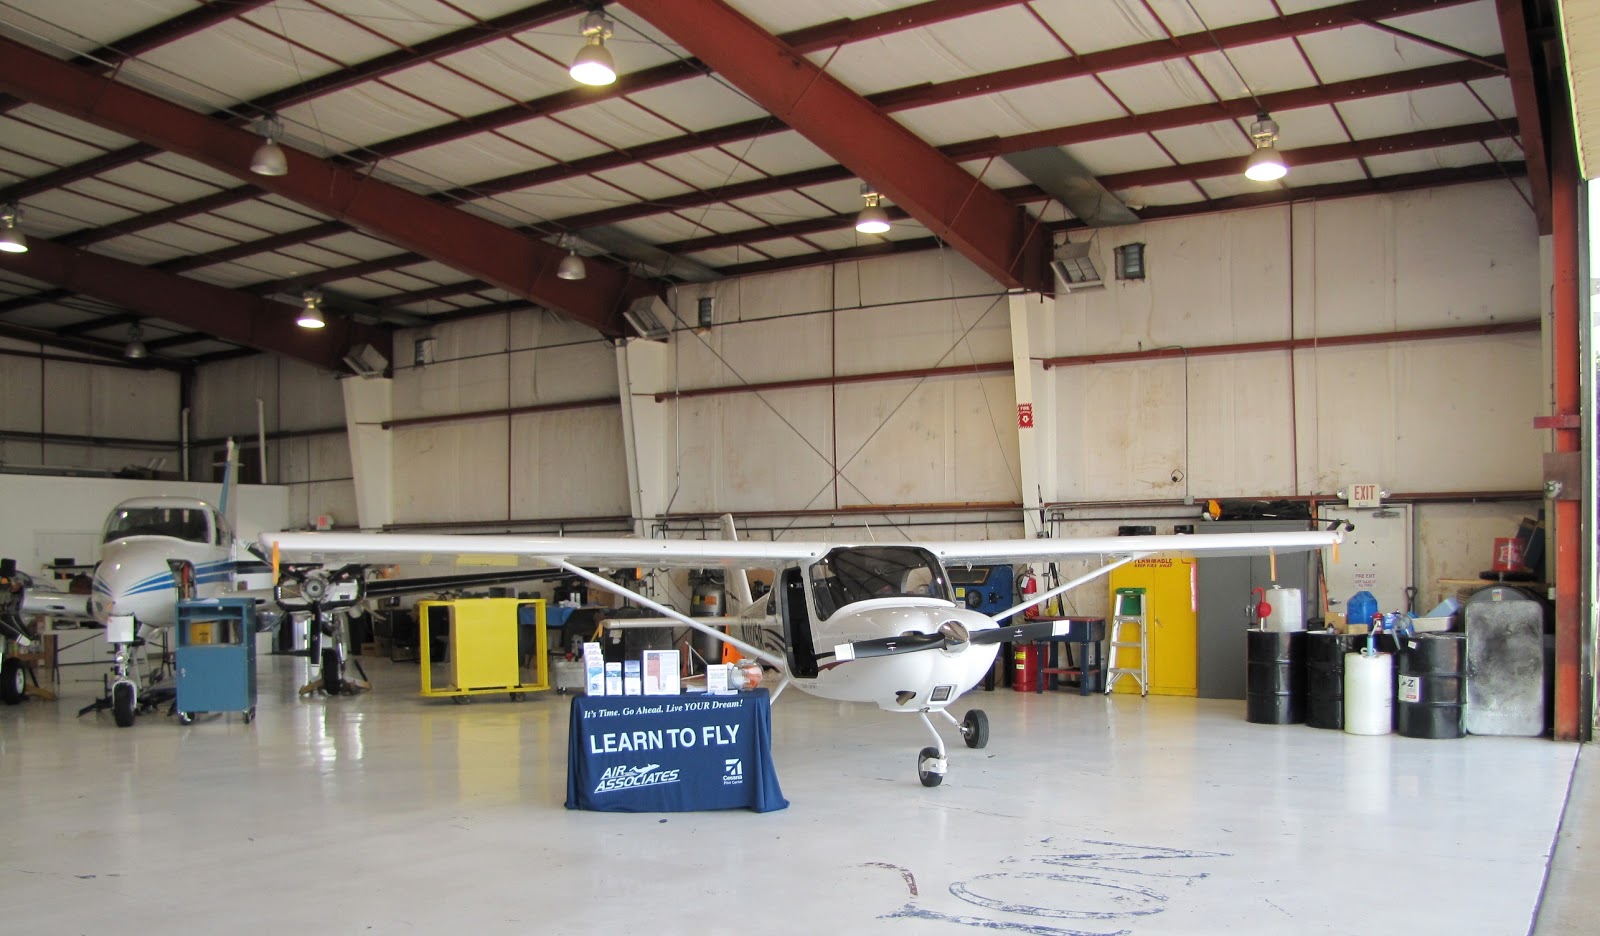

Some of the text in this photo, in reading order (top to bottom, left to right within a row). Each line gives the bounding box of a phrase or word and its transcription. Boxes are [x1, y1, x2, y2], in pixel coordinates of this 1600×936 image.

[1354, 485, 1375, 500] EXIT
[584, 699, 744, 719] It's Time. Go Ahead. Live YOUR Dream!
[590, 724, 740, 754] LEARN TO FLY
[594, 769, 680, 792] ASSOCIATES
[601, 765, 627, 780] AIR
